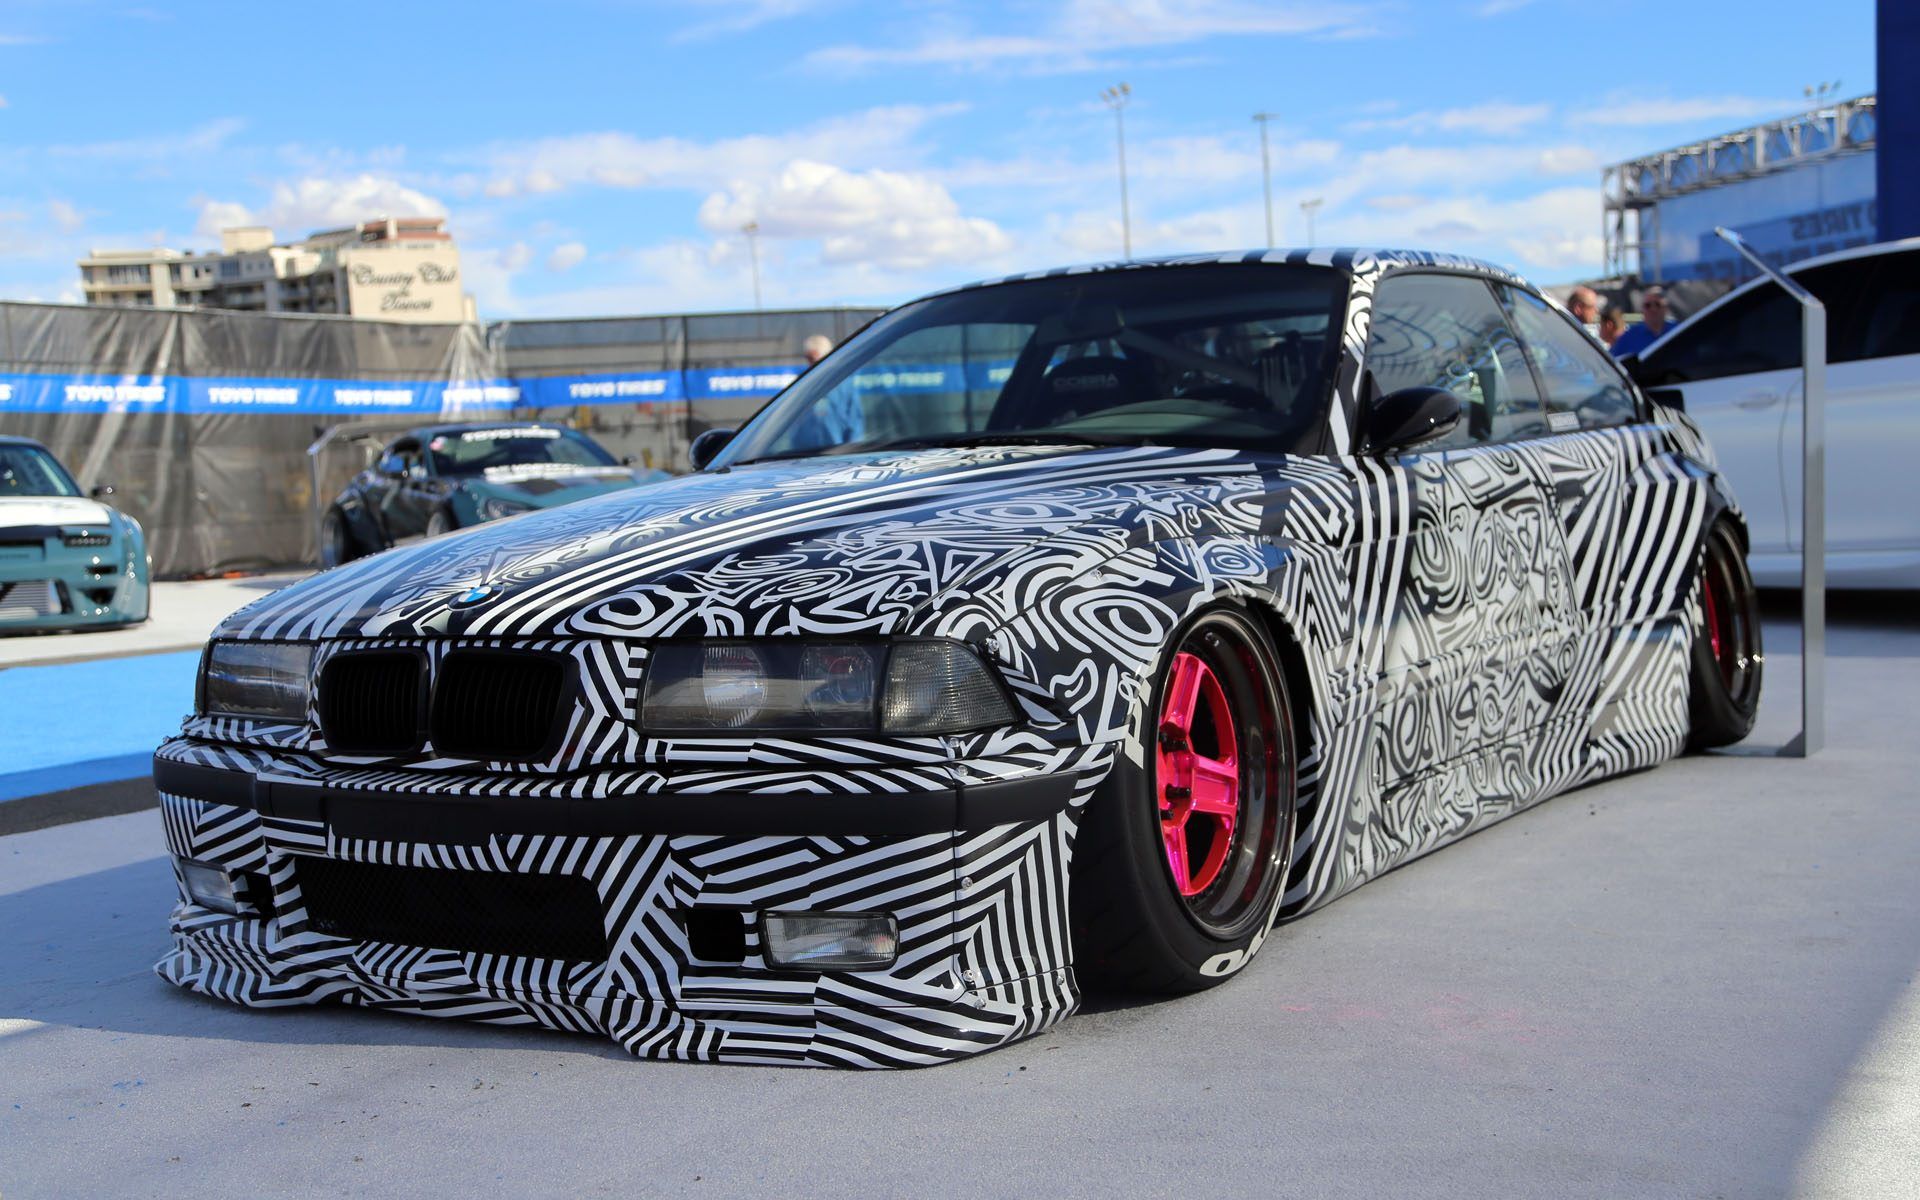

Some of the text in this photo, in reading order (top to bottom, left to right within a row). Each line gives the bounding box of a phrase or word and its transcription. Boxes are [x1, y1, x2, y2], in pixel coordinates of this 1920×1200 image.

[570, 379, 666, 398] TOYO TIRES
[709, 376, 754, 391] TOYO
[65, 385, 114, 402] TOYO
[208, 387, 254, 404] TOYO
[334, 389, 372, 405] TOYO
